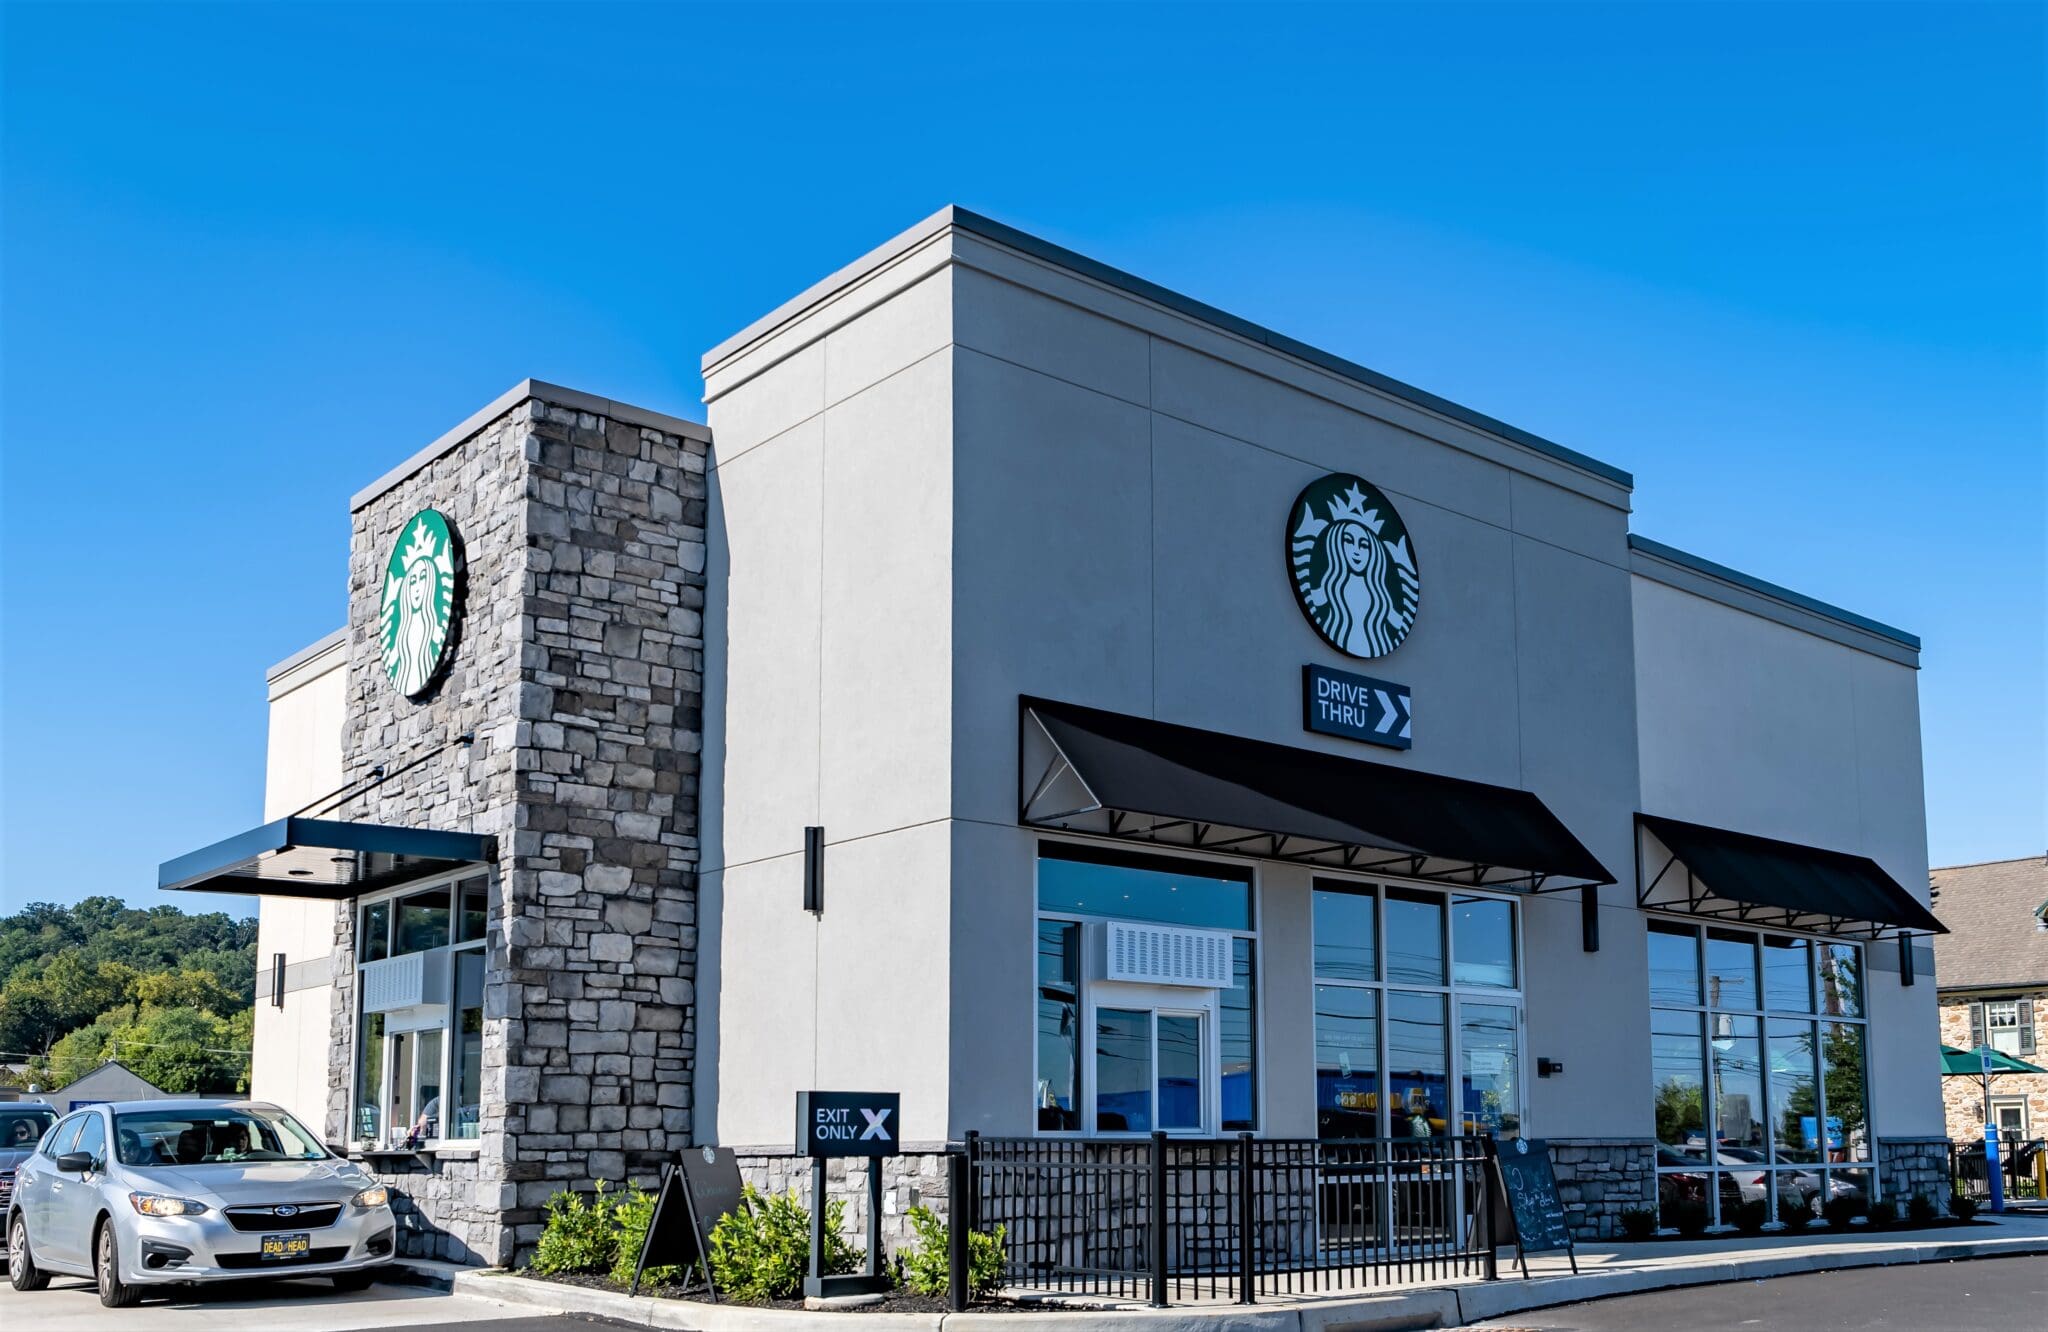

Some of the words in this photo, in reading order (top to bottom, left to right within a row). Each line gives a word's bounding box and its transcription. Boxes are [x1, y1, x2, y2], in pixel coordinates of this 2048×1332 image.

[1317, 677, 1369, 707] DRIVE
[1318, 699, 1366, 728] THRU
[816, 1108, 850, 1123] EXIT
[816, 1125, 858, 1140] ONLY
[264, 1242, 283, 1253] DEAD
[288, 1240, 307, 1251] HEAD
